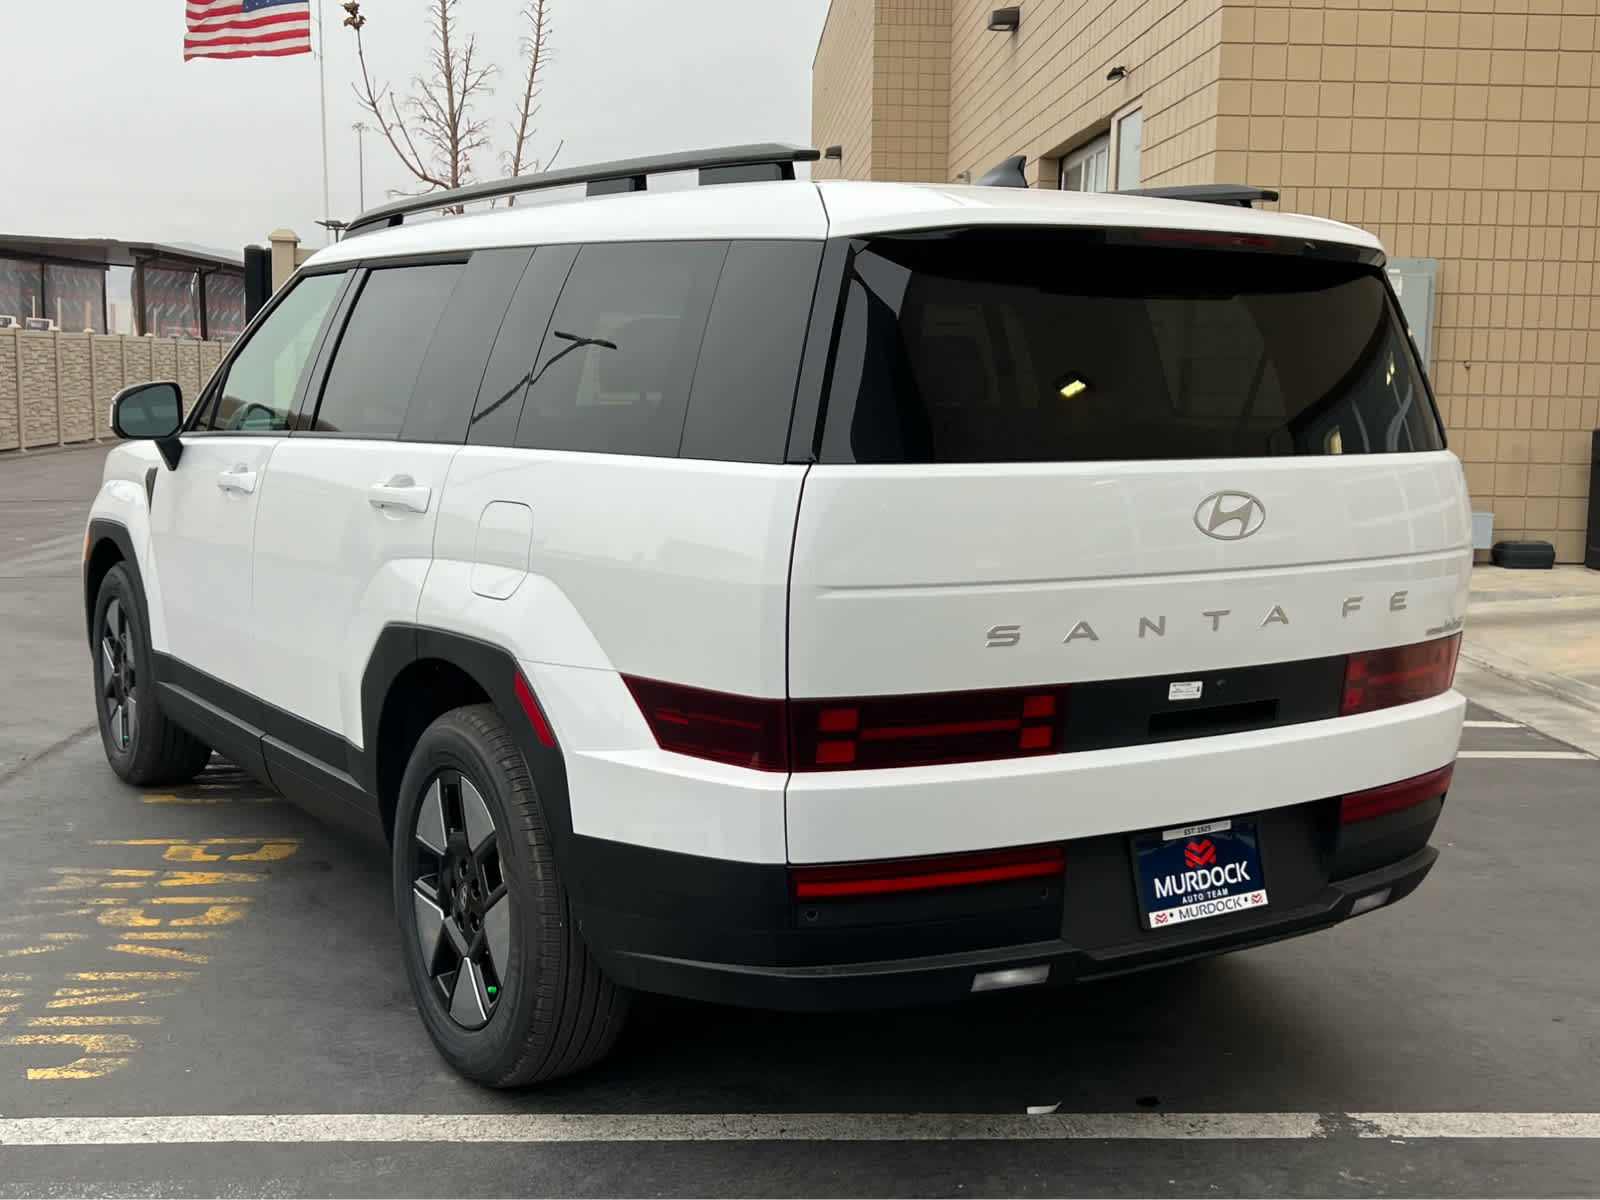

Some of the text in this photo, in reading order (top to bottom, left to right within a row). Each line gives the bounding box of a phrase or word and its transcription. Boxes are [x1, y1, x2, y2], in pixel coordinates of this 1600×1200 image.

[985, 591, 1408, 648] SANTA FE
[1154, 861, 1250, 898] MURDOCK
[1178, 897, 1242, 920] MURDOCK
[1182, 888, 1229, 904] AUTO TEAM
